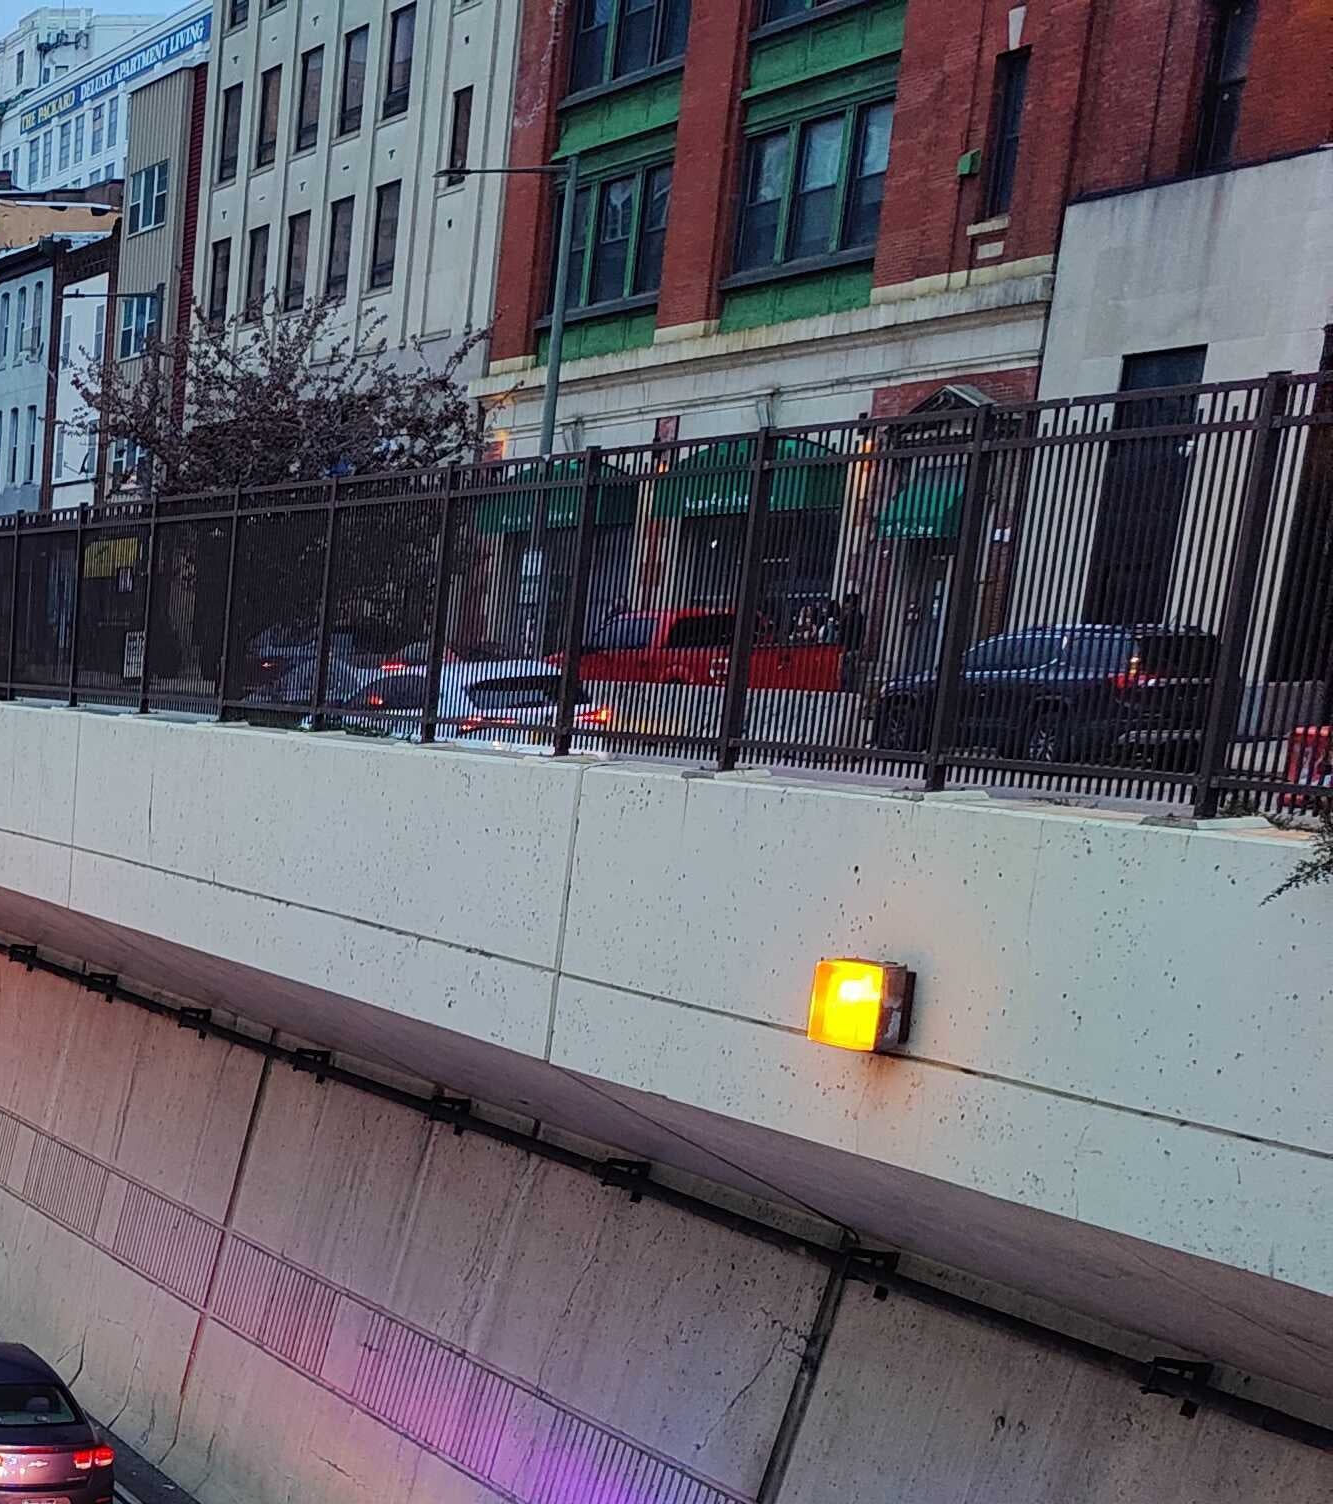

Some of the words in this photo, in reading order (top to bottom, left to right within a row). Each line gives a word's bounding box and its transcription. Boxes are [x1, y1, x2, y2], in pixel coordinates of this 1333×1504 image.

[21, 110, 36, 130] THE
[38, 90, 75, 121] PACKARD
[80, 71, 112, 101] DELUXE
[112, 43, 167, 83] APARTMENT
[169, 19, 204, 50] LIVING
